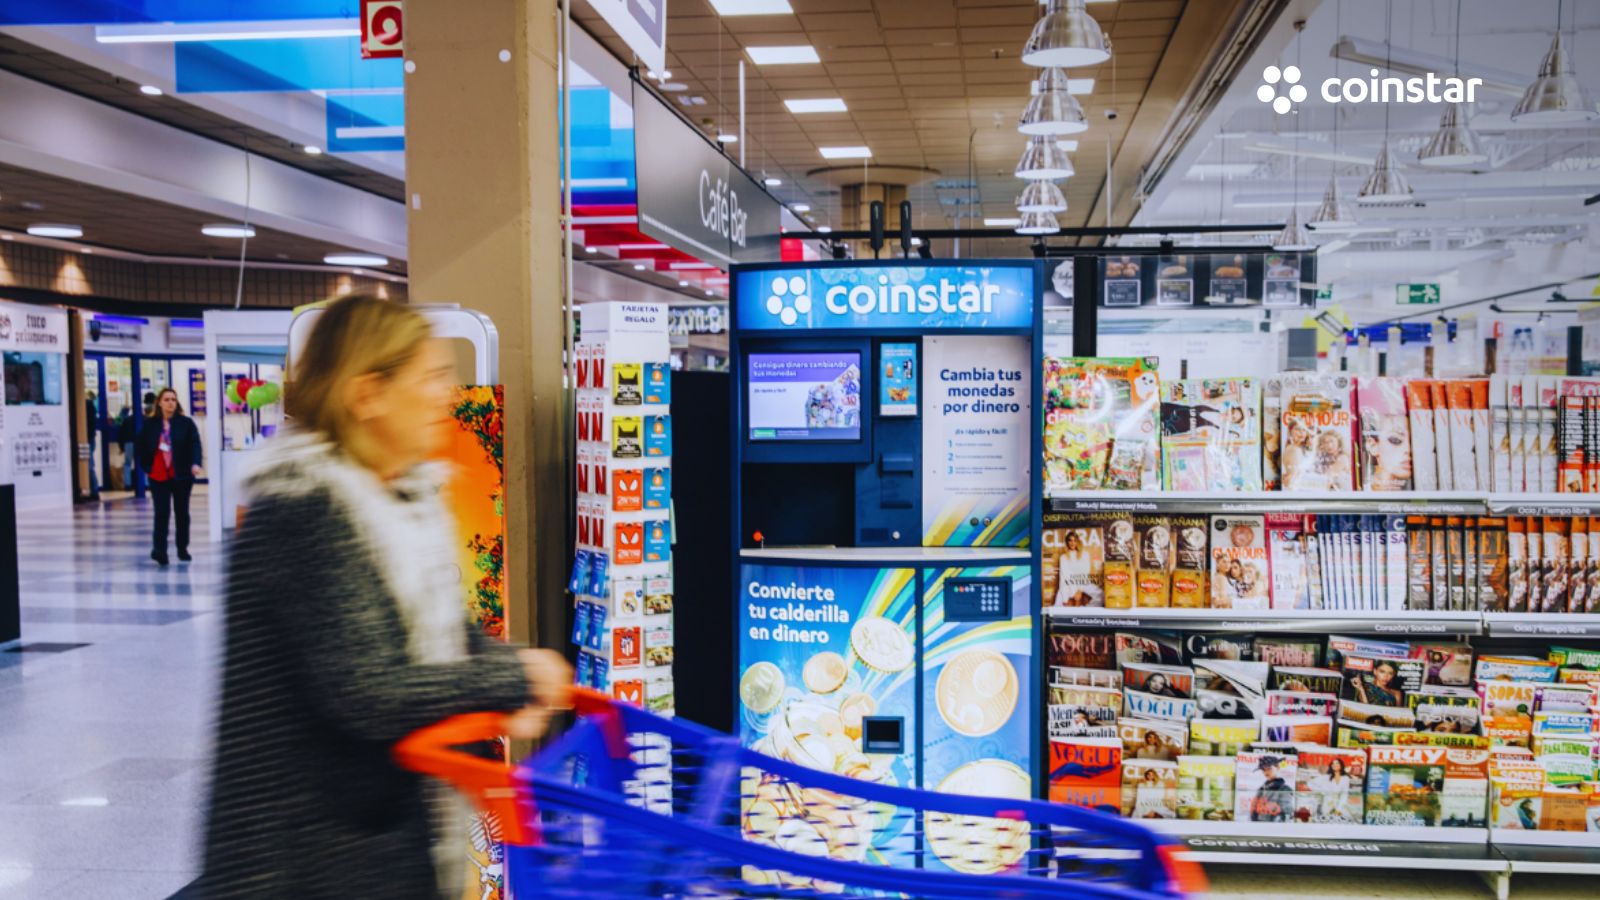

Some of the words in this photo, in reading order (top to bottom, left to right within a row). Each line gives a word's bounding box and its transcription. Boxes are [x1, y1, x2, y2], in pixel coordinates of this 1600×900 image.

[700, 169, 728, 238] Café
[730, 190, 748, 247] Bar
[825, 274, 1000, 314] coinstar
[622, 305, 659, 313] TARJETAS
[940, 367, 995, 381] Cambia
[998, 369, 1022, 381] tus
[948, 383, 1015, 397] monedas
[943, 402, 968, 415] por
[971, 400, 1020, 413] dinero
[748, 581, 835, 601] Convierte
[748, 603, 767, 619] tu
[769, 604, 850, 623] calderilla
[749, 627, 769, 640] en
[772, 623, 830, 644] dinero
[1488, 685, 1532, 701] SOPAS
[1127, 693, 1195, 718] VOGUE
[1052, 740, 1121, 764] VOGUE
[1123, 766, 1176, 780] CLRA
[1187, 837, 1281, 850] Corazón,
[1284, 840, 1380, 852] sociedad
